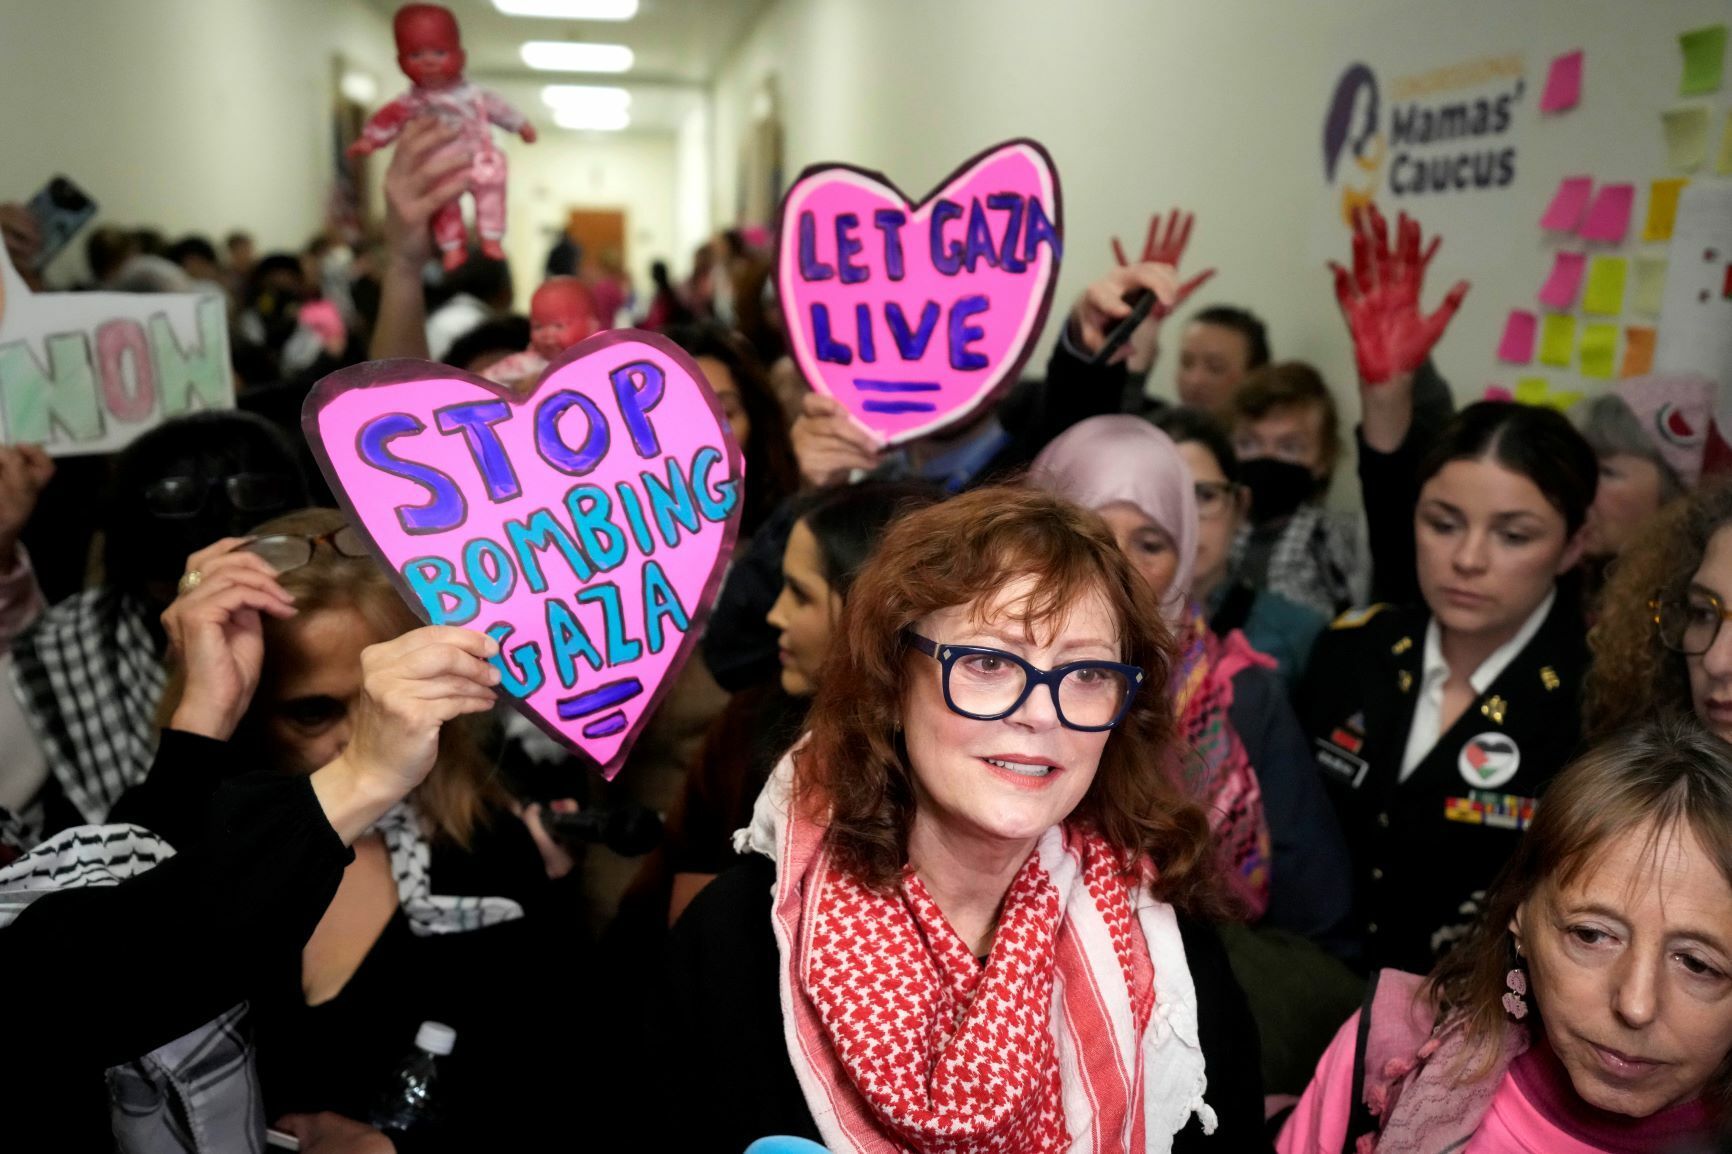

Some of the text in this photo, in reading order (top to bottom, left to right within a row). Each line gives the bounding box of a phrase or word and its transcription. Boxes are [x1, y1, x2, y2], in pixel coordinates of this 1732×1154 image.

[798, 191, 1063, 284] LET GAZA
[1389, 147, 1515, 196] Caucus
[0, 296, 226, 444] NOW
[810, 295, 990, 371] LIVE
[355, 360, 666, 536] STOP
[400, 446, 739, 627] BOMBING
[484, 559, 690, 699] GAZA
